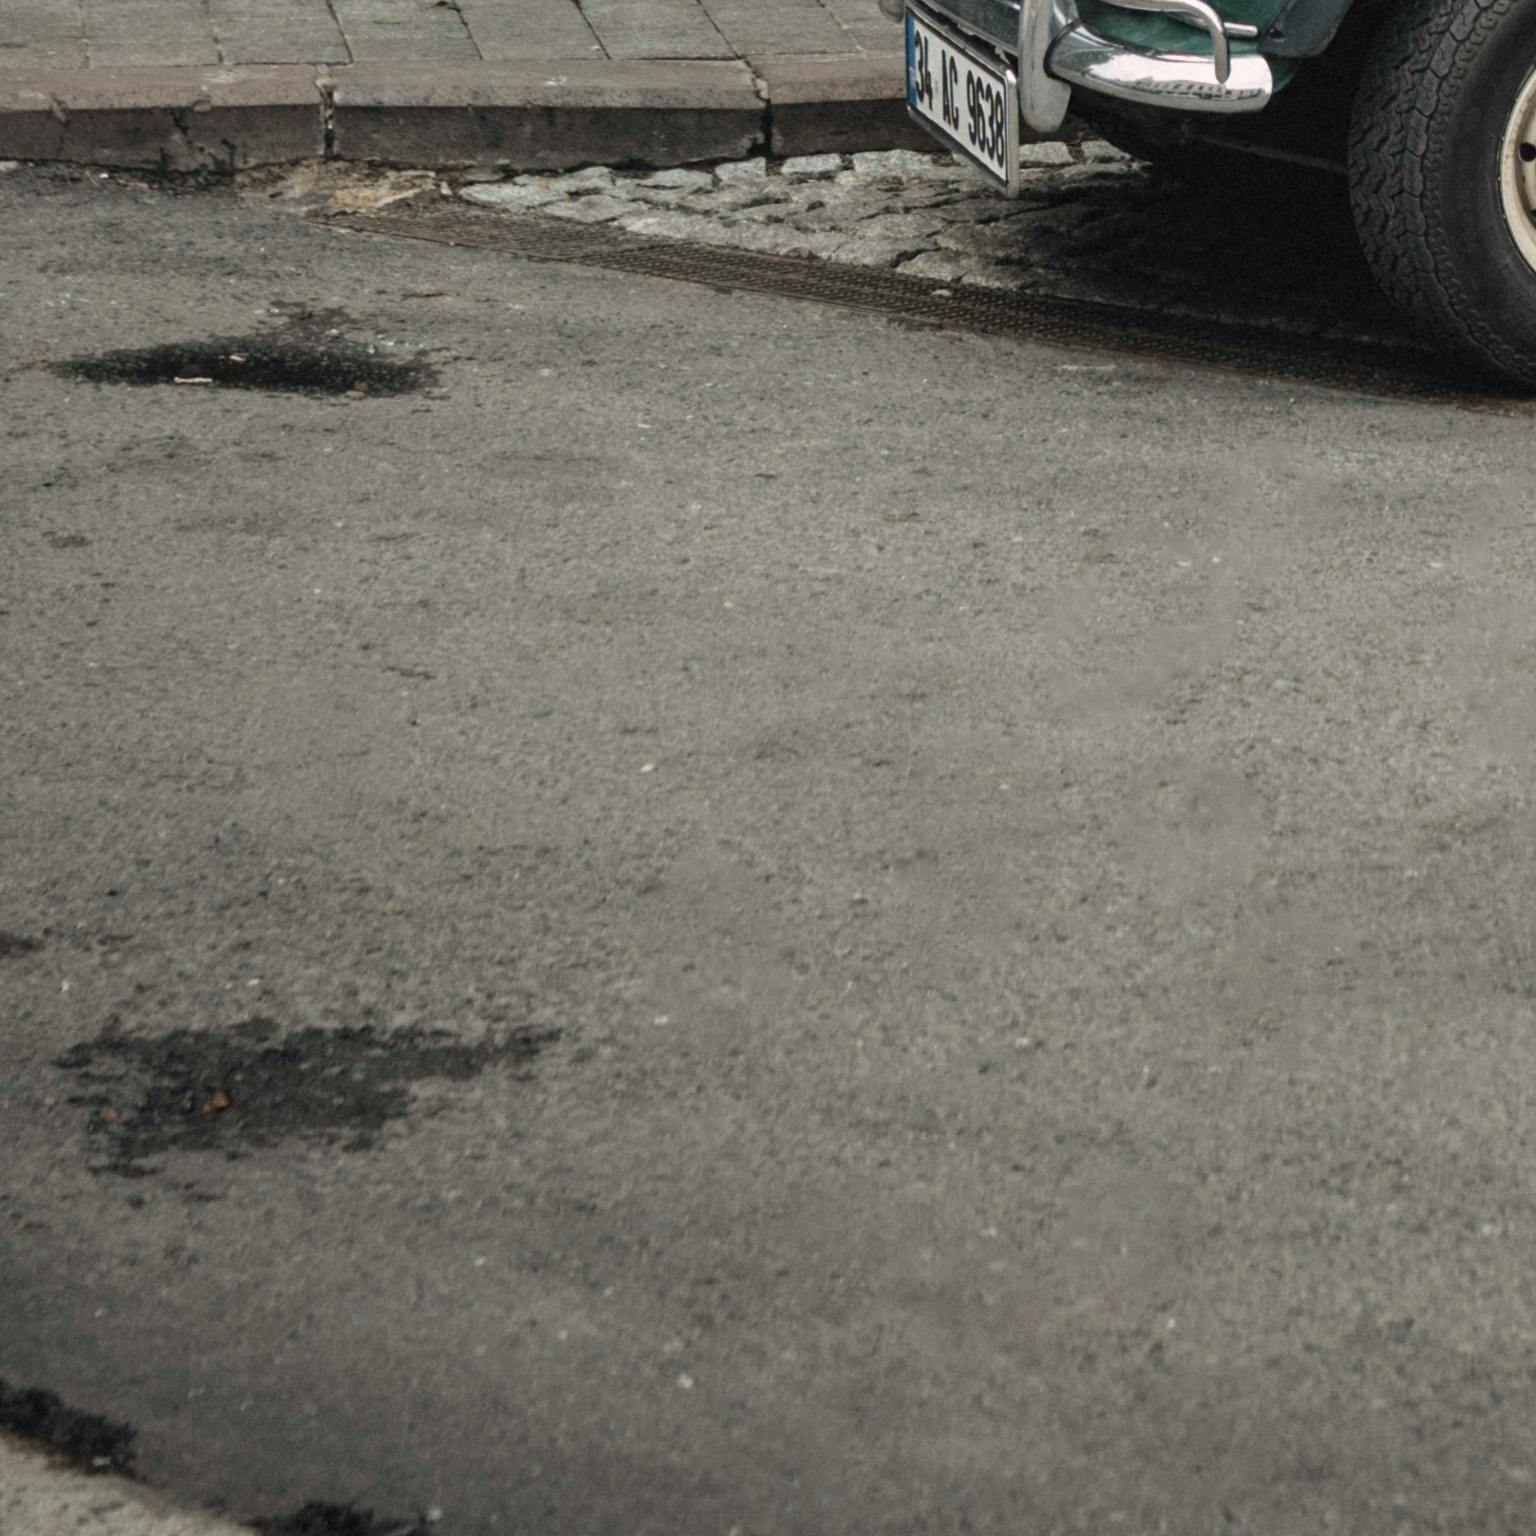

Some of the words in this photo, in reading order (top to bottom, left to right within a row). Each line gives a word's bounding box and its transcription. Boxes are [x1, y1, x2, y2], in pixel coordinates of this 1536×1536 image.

[914, 29, 934, 112] 34
[941, 48, 960, 132] AC
[966, 68, 1005, 168] 9638
